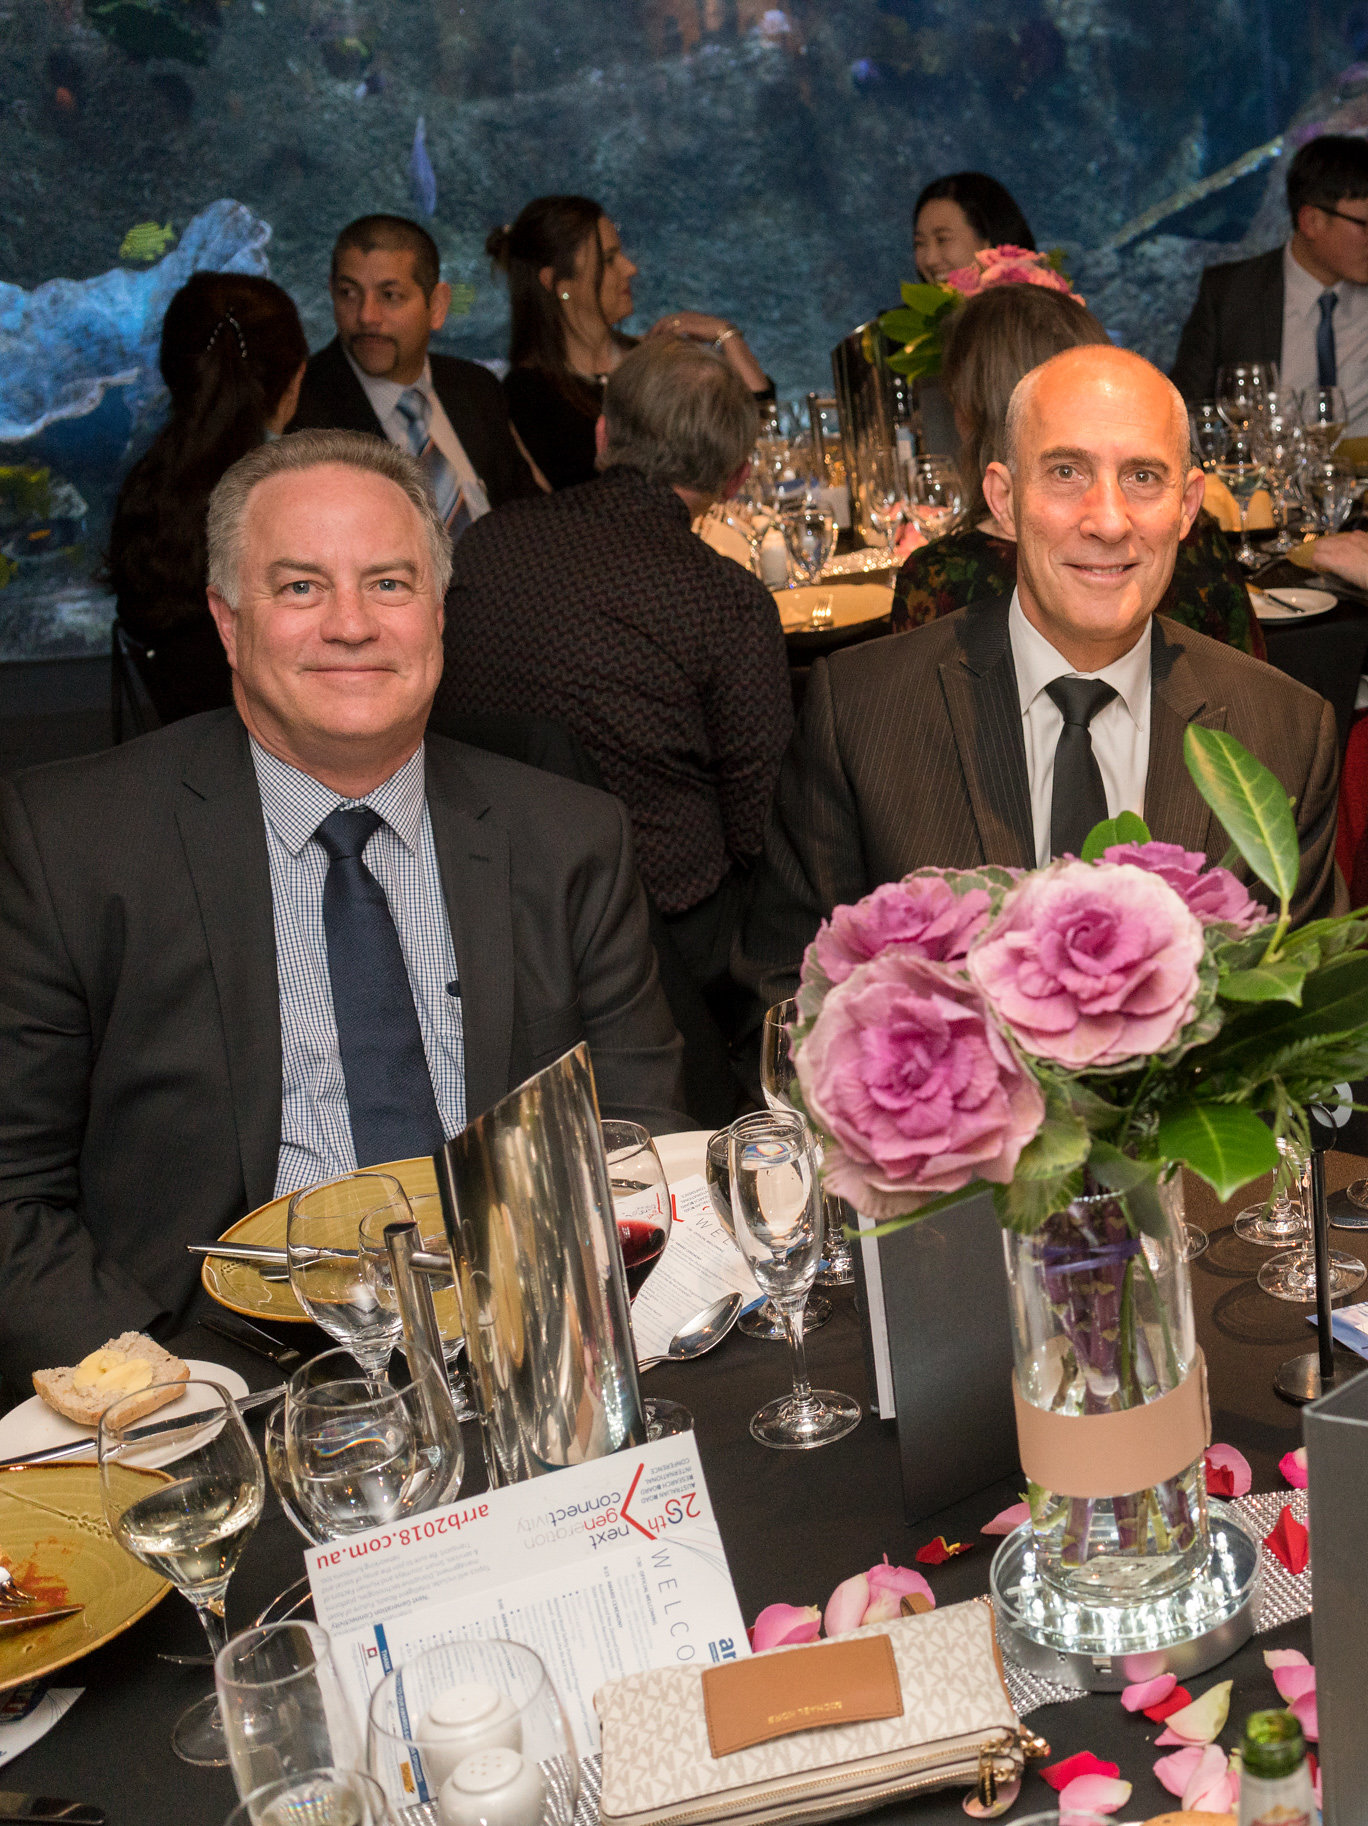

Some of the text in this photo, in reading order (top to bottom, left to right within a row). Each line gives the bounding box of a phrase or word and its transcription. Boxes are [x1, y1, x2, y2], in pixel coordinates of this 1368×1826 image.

[644, 1465, 692, 1484] INTERNATIONAL
[649, 1457, 690, 1474] CONFERENCE
[639, 1474, 693, 1495] RESEARCH BOARD
[640, 1493, 658, 1503] ROAD
[513, 1490, 622, 1533] connectivity
[315, 1503, 490, 1569] arrb2018.com.au
[522, 1507, 618, 1550] generation
[588, 1524, 629, 1550] next
[650, 1548, 696, 1662] WELCO
[717, 1636, 737, 1661] ar
